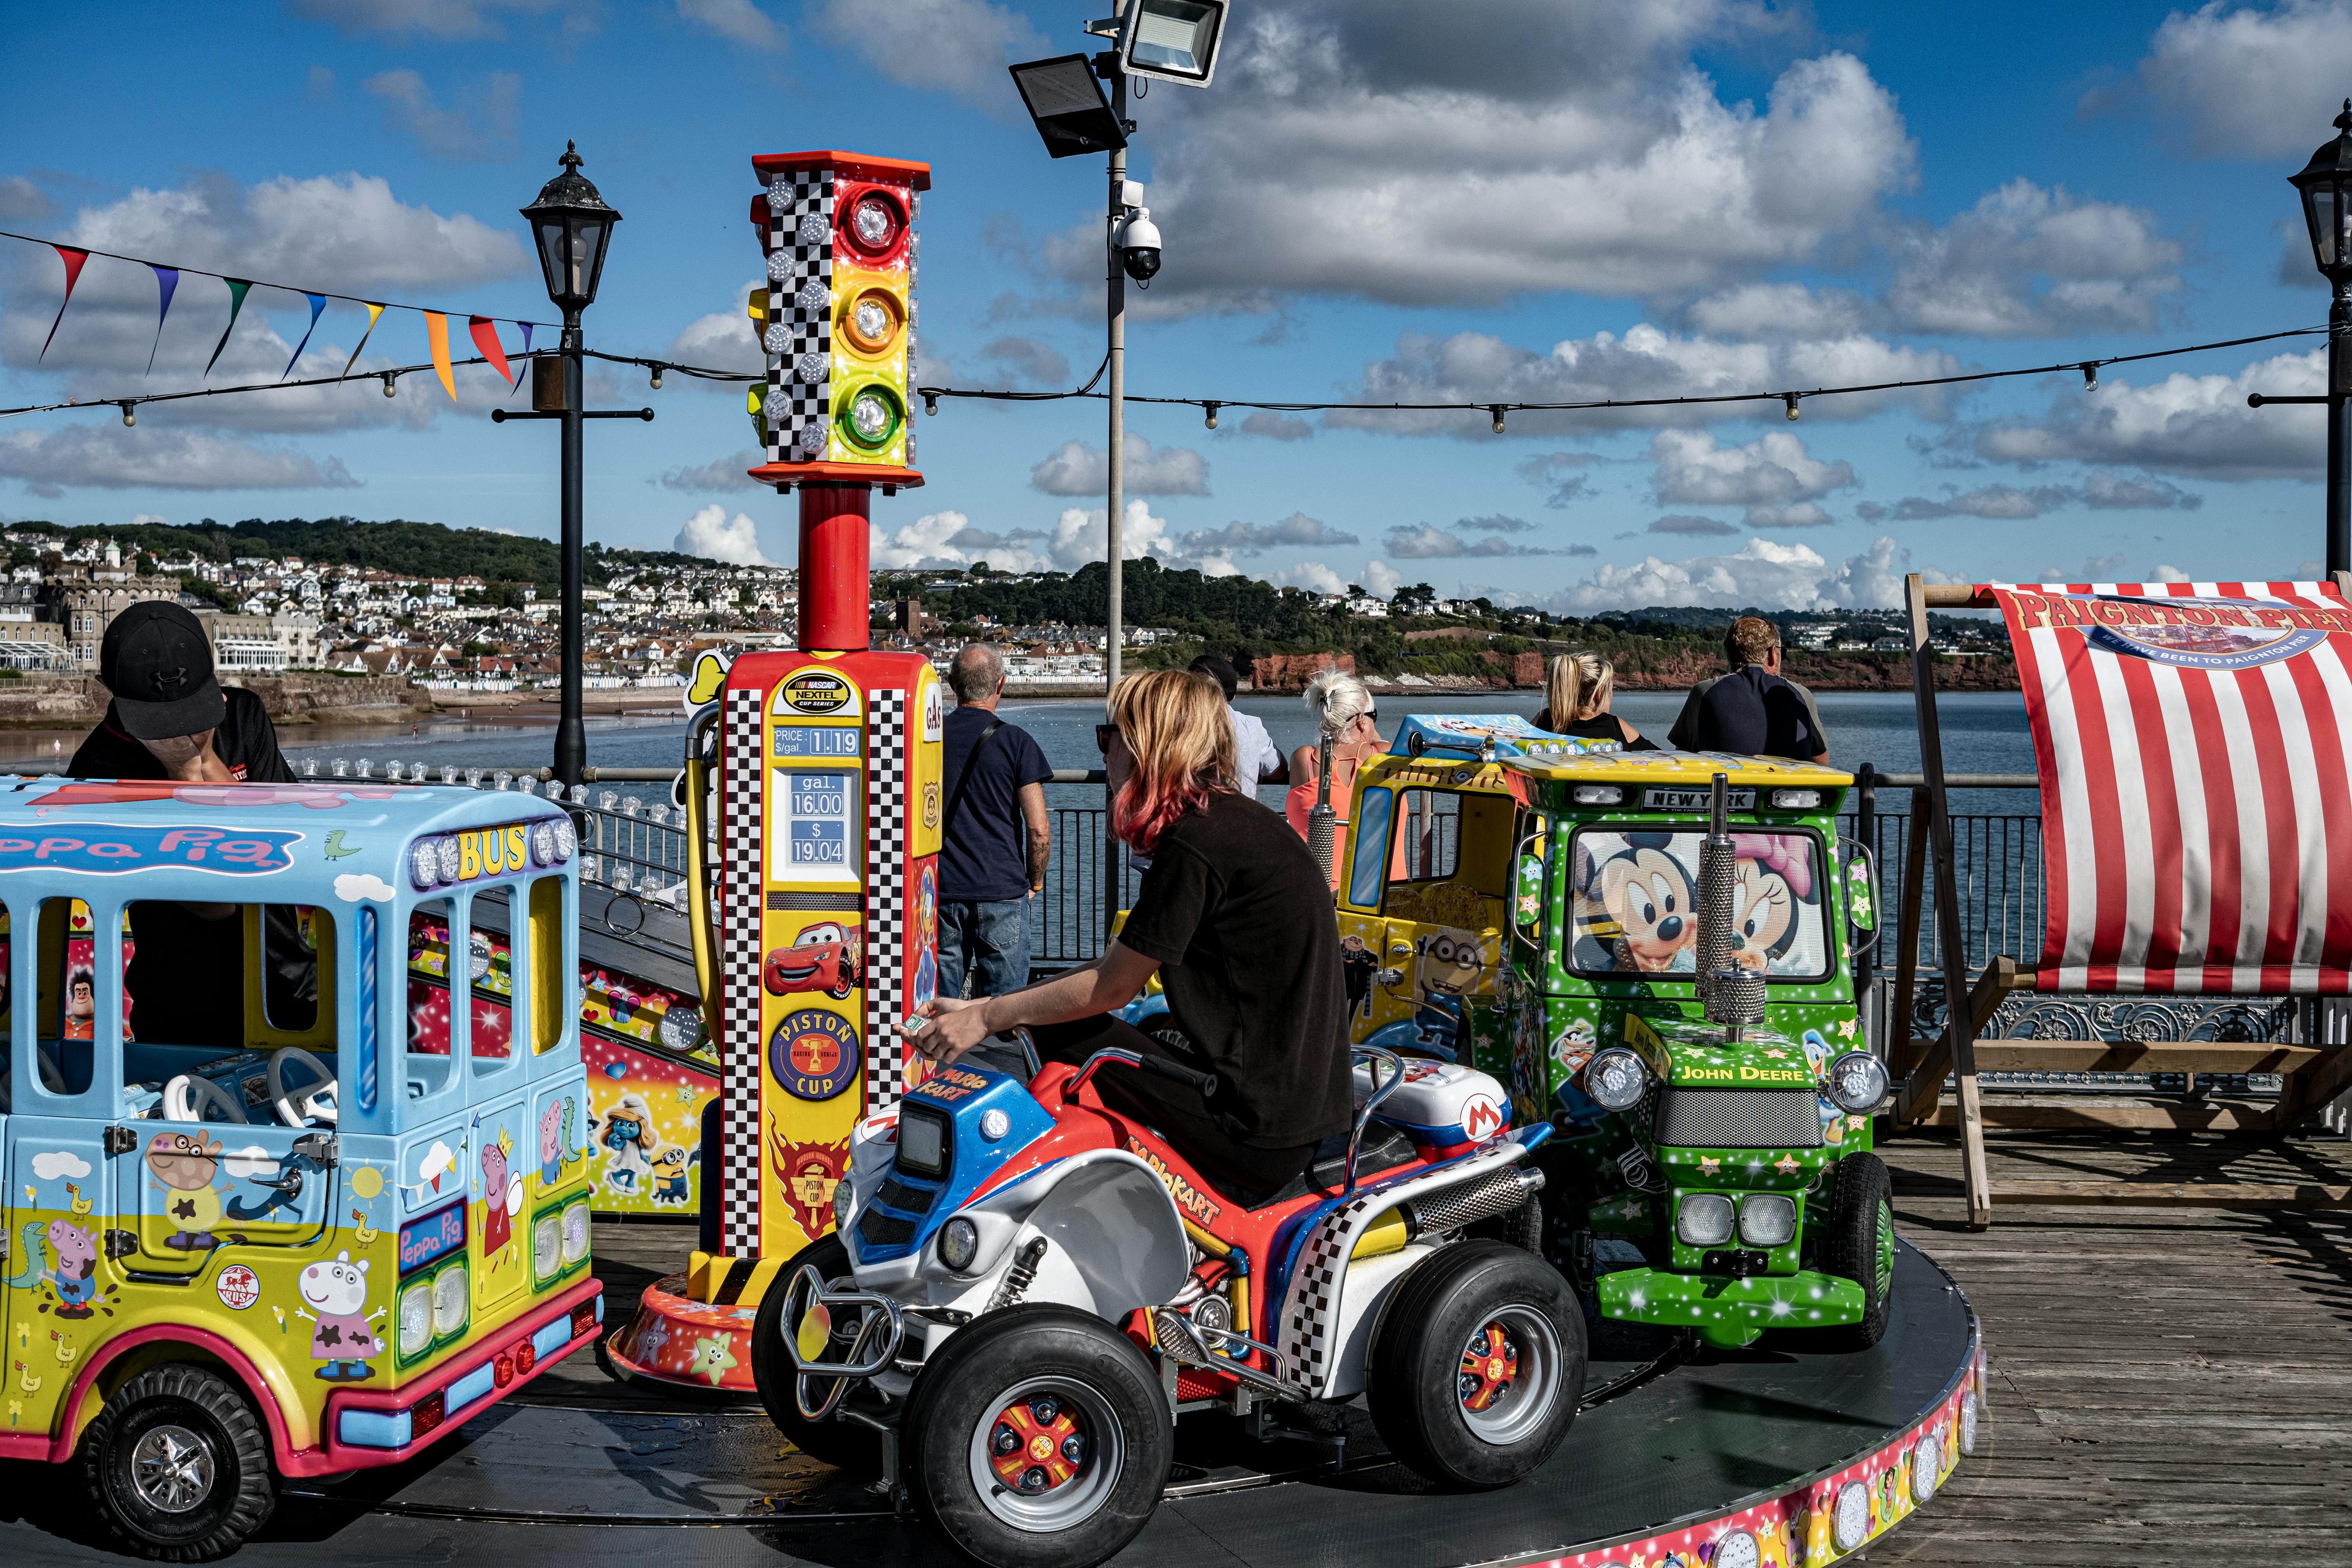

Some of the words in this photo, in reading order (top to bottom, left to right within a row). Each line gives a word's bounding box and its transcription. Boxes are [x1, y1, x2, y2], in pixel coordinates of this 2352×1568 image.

[2011, 593, 2250, 628] PAIGNTON
[2253, 609, 2352, 631] PIER
[2102, 634, 2121, 644] WE
[2122, 642, 2157, 656] HAVE
[2160, 652, 2198, 663] BEEN
[2225, 645, 2293, 665] PAIGNTON
[2288, 635, 2311, 647] PIER
[796, 691, 837, 699] NEXTEL
[926, 694, 941, 730] GAS
[775, 743, 802, 754] $/gal.
[814, 732, 856, 752] 1.19
[803, 776, 835, 790] gal.
[794, 795, 842, 813] 16.00
[1653, 792, 1697, 806] NEW
[1700, 794, 1747, 807] YRK
[812, 822, 821, 838] $
[158, 830, 283, 867] Pig
[457, 822, 526, 882] BUS
[794, 842, 842, 861] 19.04
[779, 1014, 852, 1044] PISTON
[1634, 1025, 1643, 1049] JOHN
[935, 1069, 989, 1090] MARIO
[1681, 1066, 1733, 1080] JOHN
[1739, 1066, 1804, 1081] DEERE
[796, 1077, 834, 1095] CUP
[915, 1081, 974, 1102] KART
[797, 1151, 815, 1166] HUDSON
[816, 1151, 834, 1168] HORNET
[806, 1180, 824, 1190] PISTON
[809, 1192, 820, 1203] CUP
[1171, 1174, 1221, 1227] KART
[400, 1230, 440, 1266] Peppa
[442, 1212, 463, 1246] Pig
